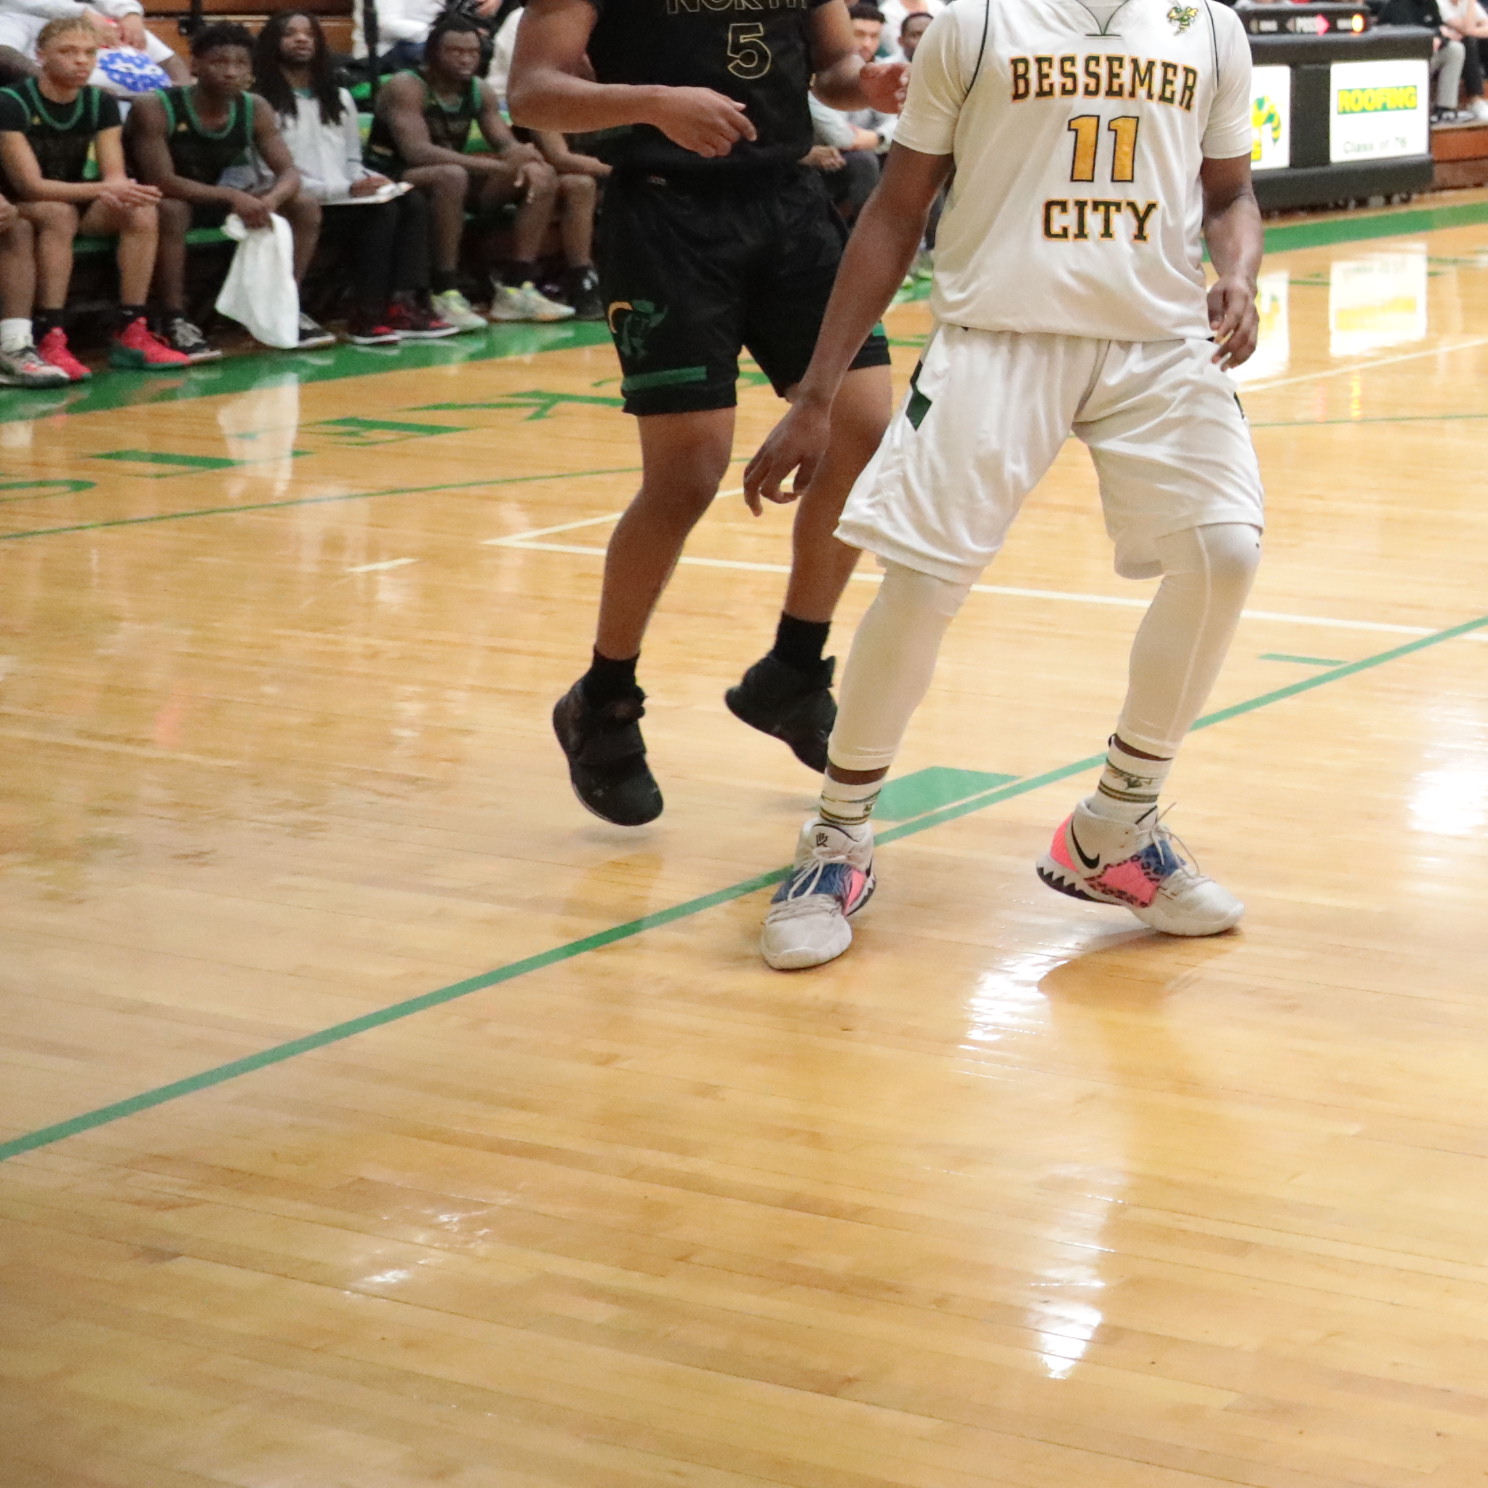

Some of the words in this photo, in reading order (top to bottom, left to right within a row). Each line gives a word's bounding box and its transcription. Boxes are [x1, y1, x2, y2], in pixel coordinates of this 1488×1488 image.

[726, 22, 772, 80] 5
[1009, 53, 1199, 112] BESSEMER
[1338, 86, 1417, 113] ROOFING
[1067, 114, 1140, 183] 11
[1343, 139, 1375, 155] Class
[1042, 198, 1158, 243] CITY
